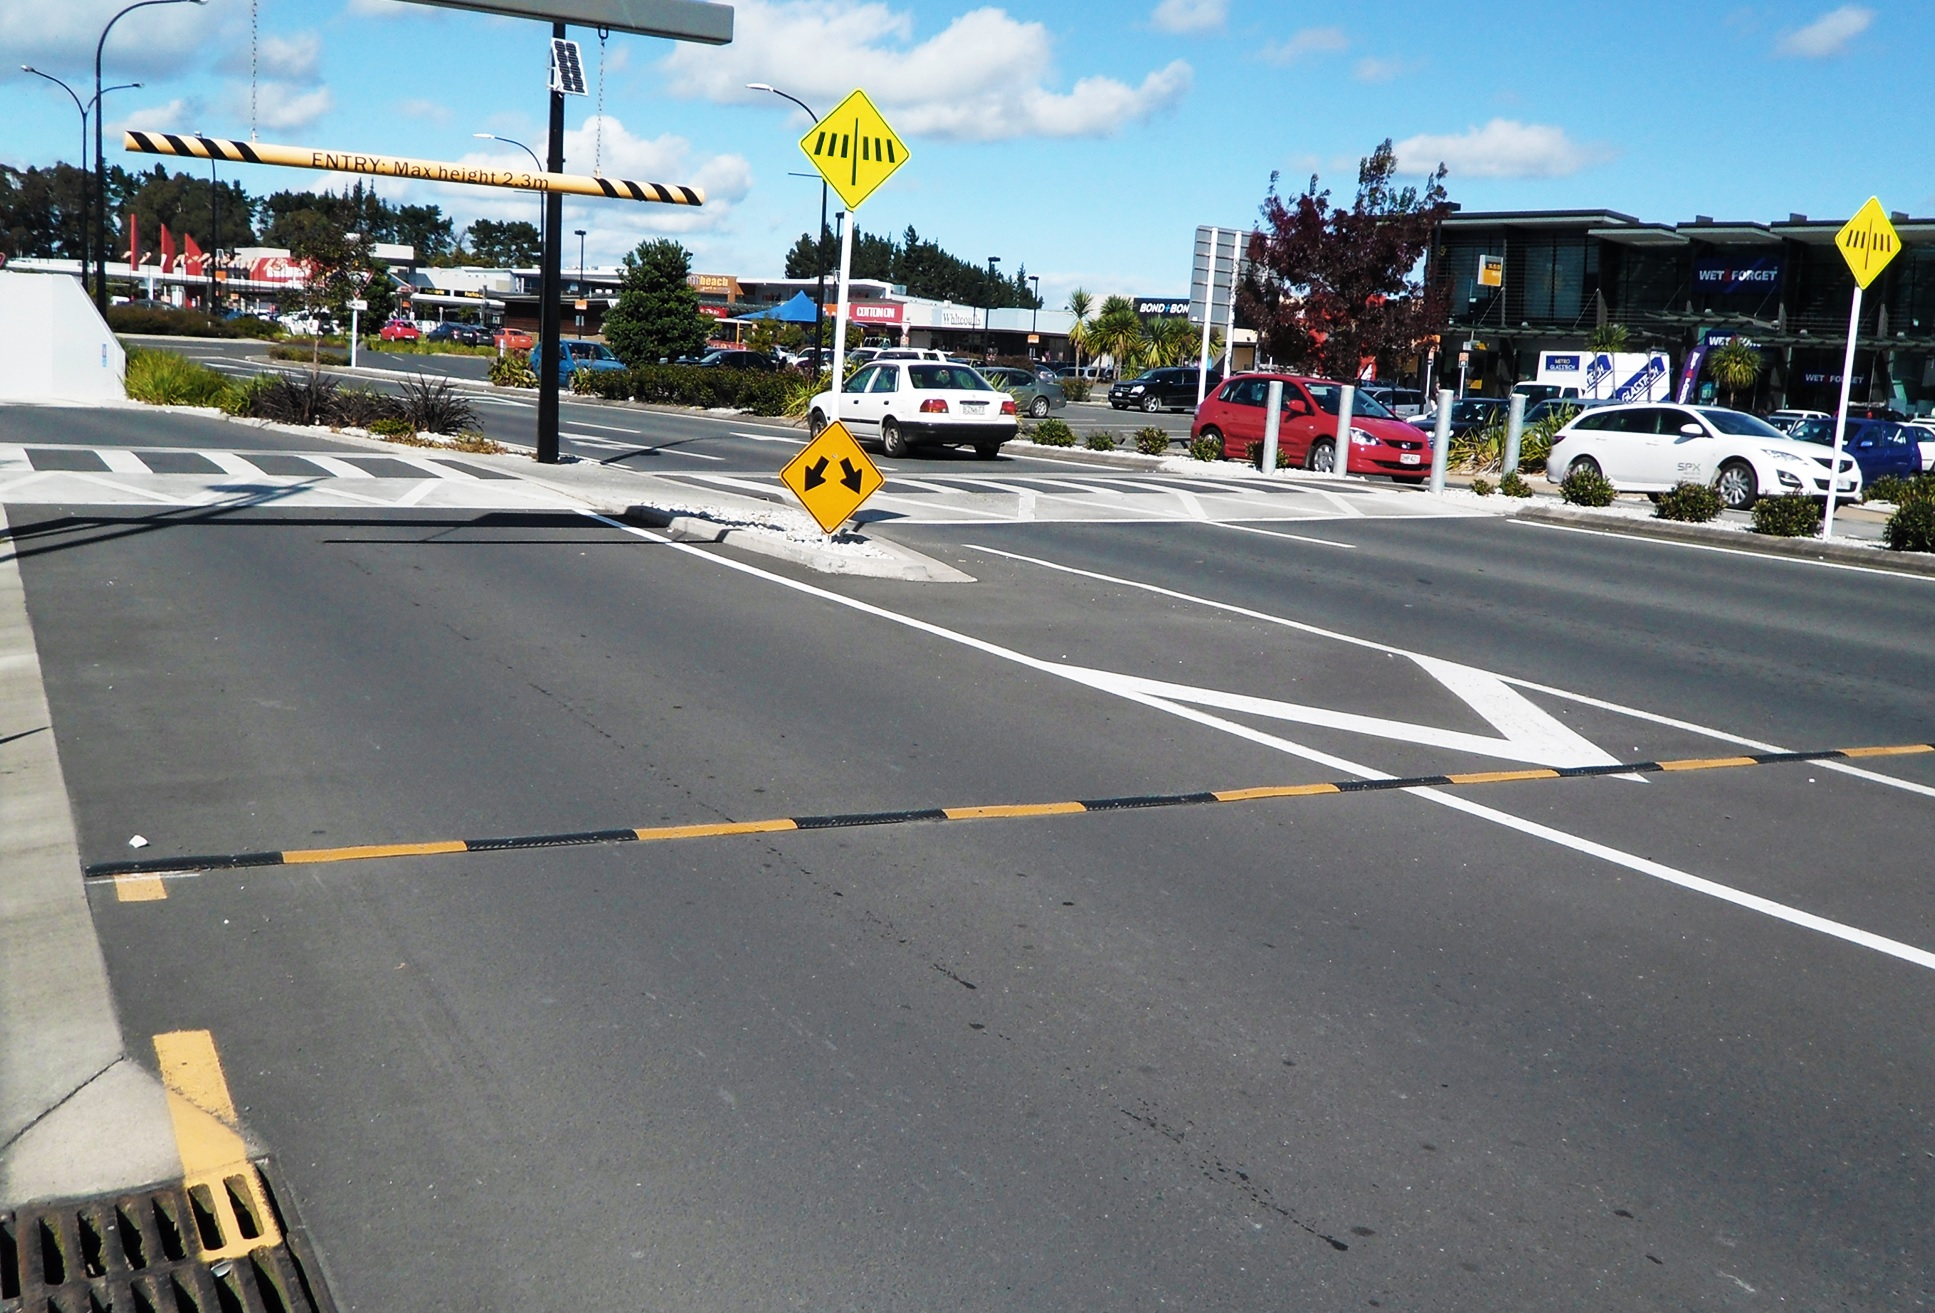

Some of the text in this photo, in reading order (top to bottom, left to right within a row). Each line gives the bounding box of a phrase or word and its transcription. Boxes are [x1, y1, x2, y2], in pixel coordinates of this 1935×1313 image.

[312, 152, 550, 190] ENTRY: Max height 2.3m
[856, 306, 884, 318] COTTON
[943, 312, 981, 326] Whitcouls
[1677, 462, 1701, 471] SPX
